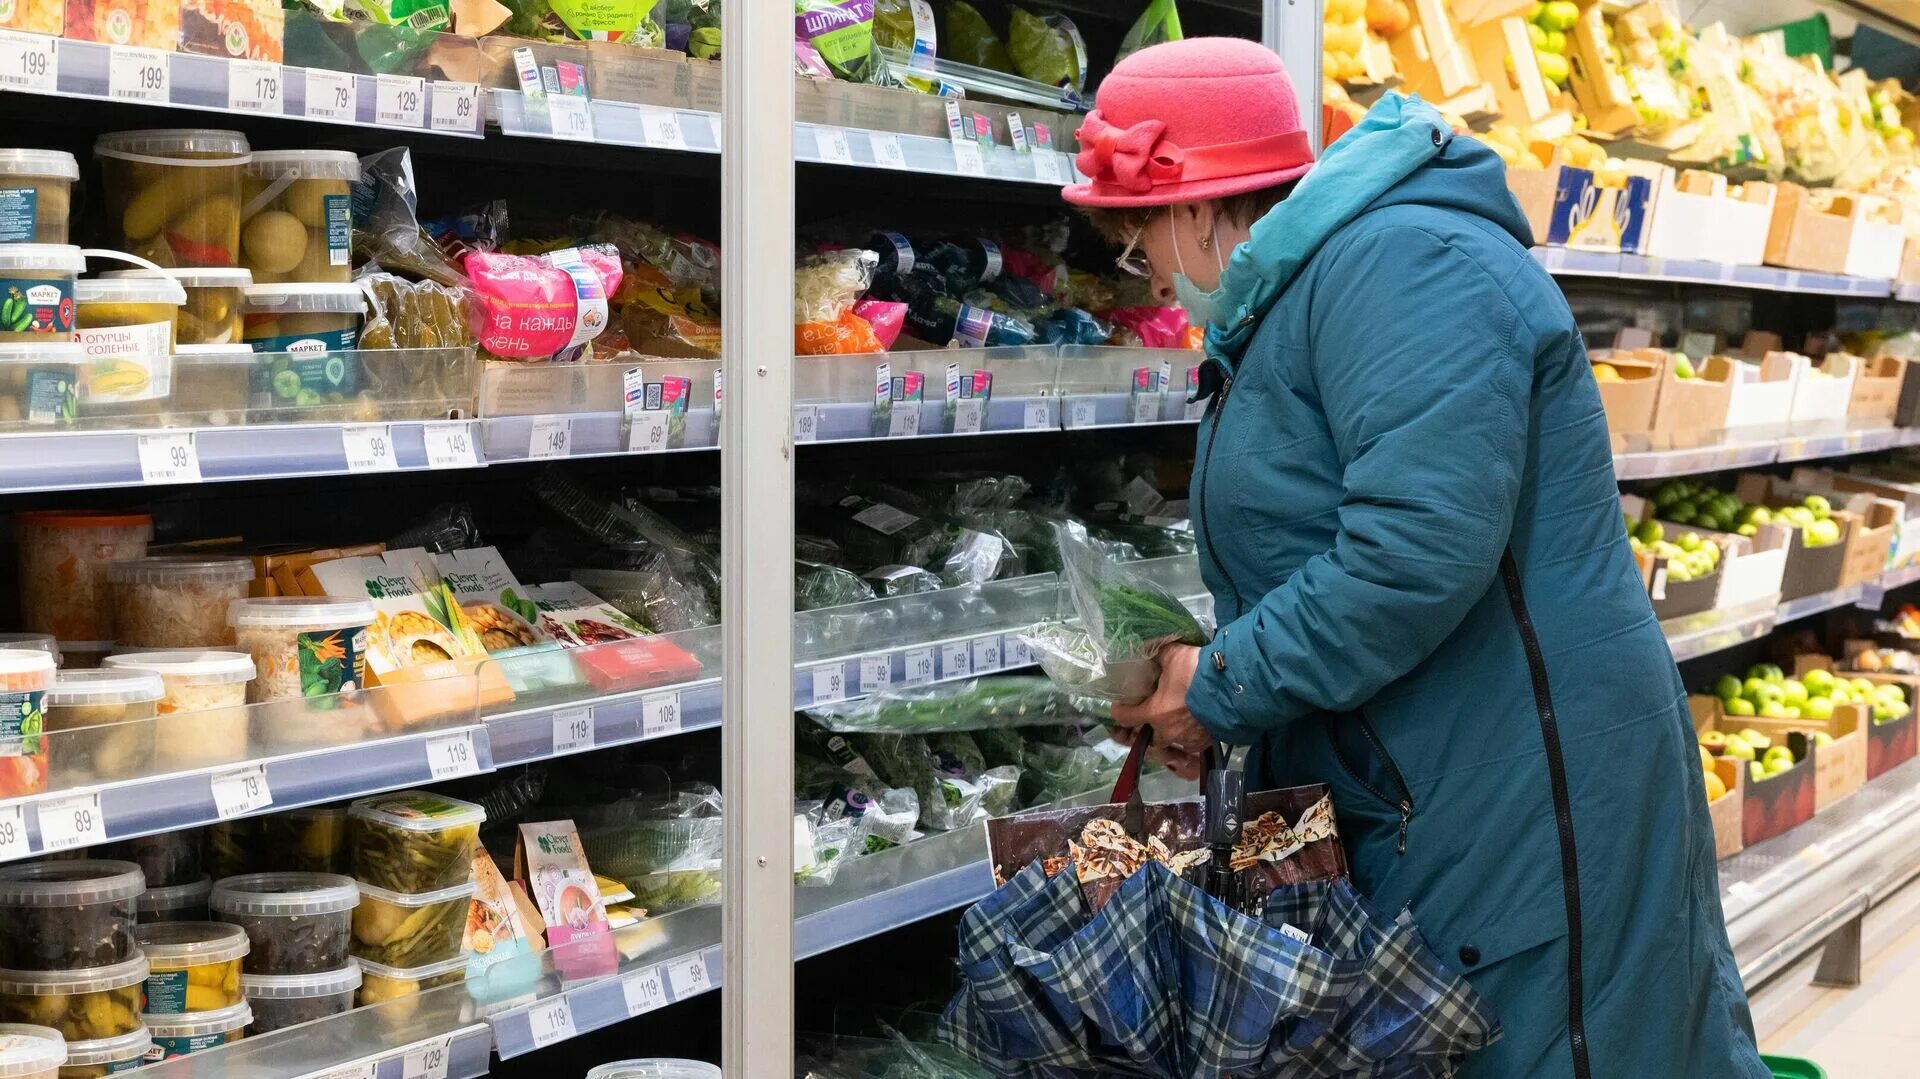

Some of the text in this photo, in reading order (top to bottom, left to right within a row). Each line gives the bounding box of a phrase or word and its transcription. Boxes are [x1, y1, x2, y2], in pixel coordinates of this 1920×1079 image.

[805, 2, 865, 33] ШПИНАТ
[20, 51, 46, 76] 199
[139, 66, 162, 90] 199
[255, 78, 276, 100] 179
[335, 86, 348, 109] 79
[397, 91, 417, 112] 129
[457, 96, 470, 116] 89
[568, 112, 585, 132] 179
[31, 291, 58, 299] МАРКЕТ
[519, 315, 576, 334] кажды
[86, 332, 131, 346] ОГУРЦЫ
[87, 343, 140, 355] СОЛЕНЫЕ
[291, 344, 323, 352] МАРКЕТ
[902, 415, 915, 430] 119
[1035, 408, 1045, 424] 129
[446, 431, 466, 454] 149
[548, 431, 564, 451] 149
[650, 425, 662, 444] 69
[171, 445, 187, 467] 99
[370, 436, 385, 457] 99
[377, 575, 407, 588] Clever
[449, 572, 479, 584] Clever
[457, 582, 485, 594] Foods
[386, 586, 412, 599] Foods
[984, 648, 996, 662] 129
[876, 665, 886, 681] 99
[917, 659, 929, 675] 119
[830, 674, 840, 692] 99
[658, 704, 674, 723] 109
[570, 720, 587, 740] 119
[447, 743, 467, 764] 119
[242, 777, 259, 798] 79
[74, 809, 92, 832] 89
[546, 833, 569, 845] Clever
[552, 843, 572, 854] Foods
[690, 963, 701, 983] 59
[640, 978, 657, 999] 119
[548, 1007, 566, 1030] 119
[422, 1049, 441, 1071] 129
